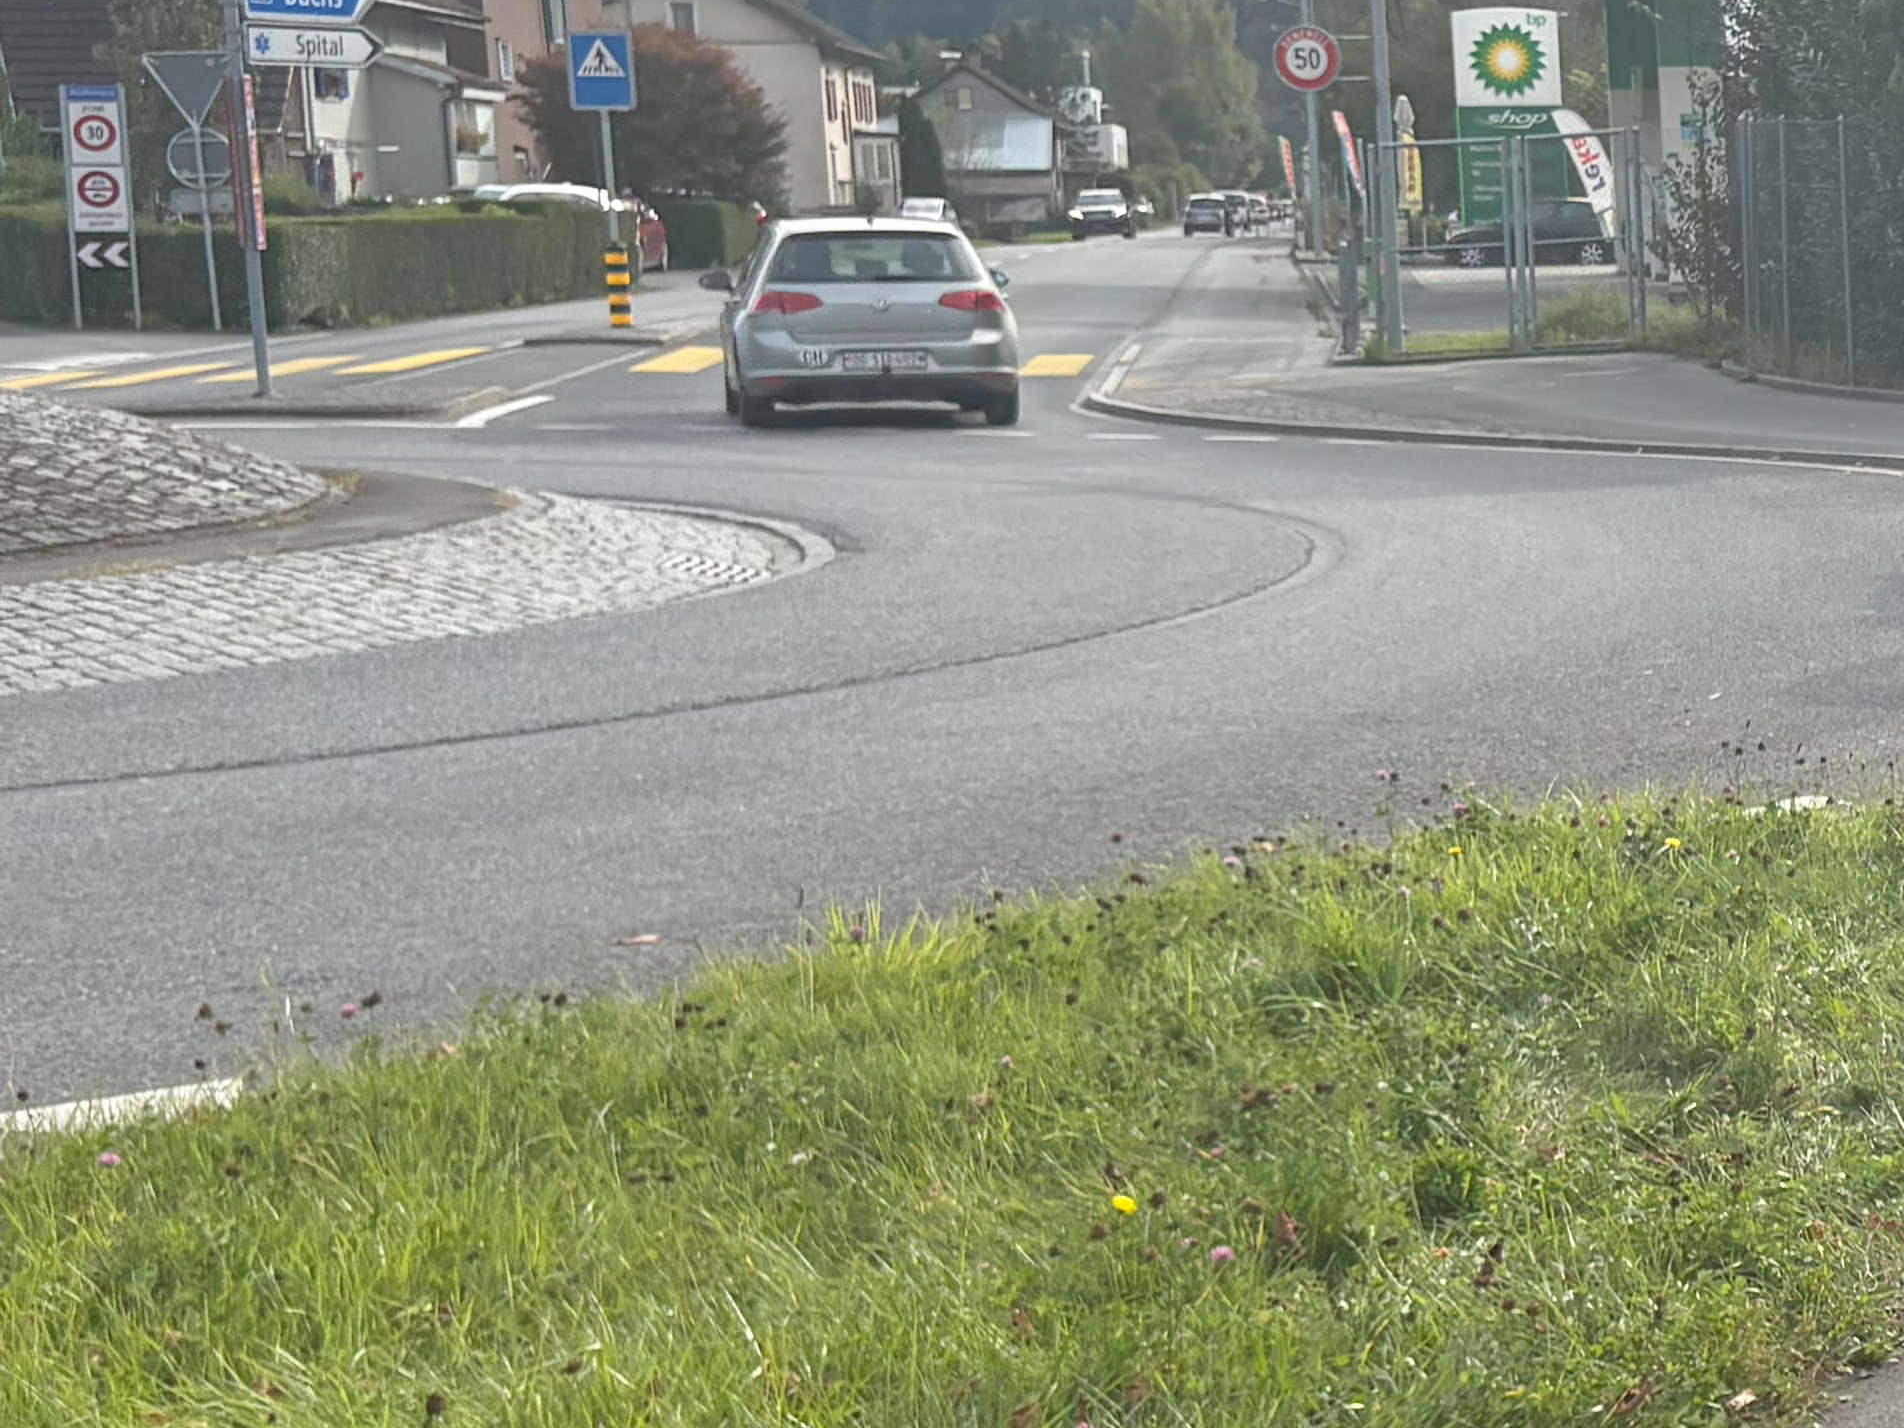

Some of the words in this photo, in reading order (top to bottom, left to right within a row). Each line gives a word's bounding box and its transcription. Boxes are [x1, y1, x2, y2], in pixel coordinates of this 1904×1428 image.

[1526, 13, 1547, 28] bp
[295, 34, 344, 59] Spital
[1293, 47, 1321, 70] 50
[1487, 109, 1550, 128] shop
[86, 126, 104, 140] 30
